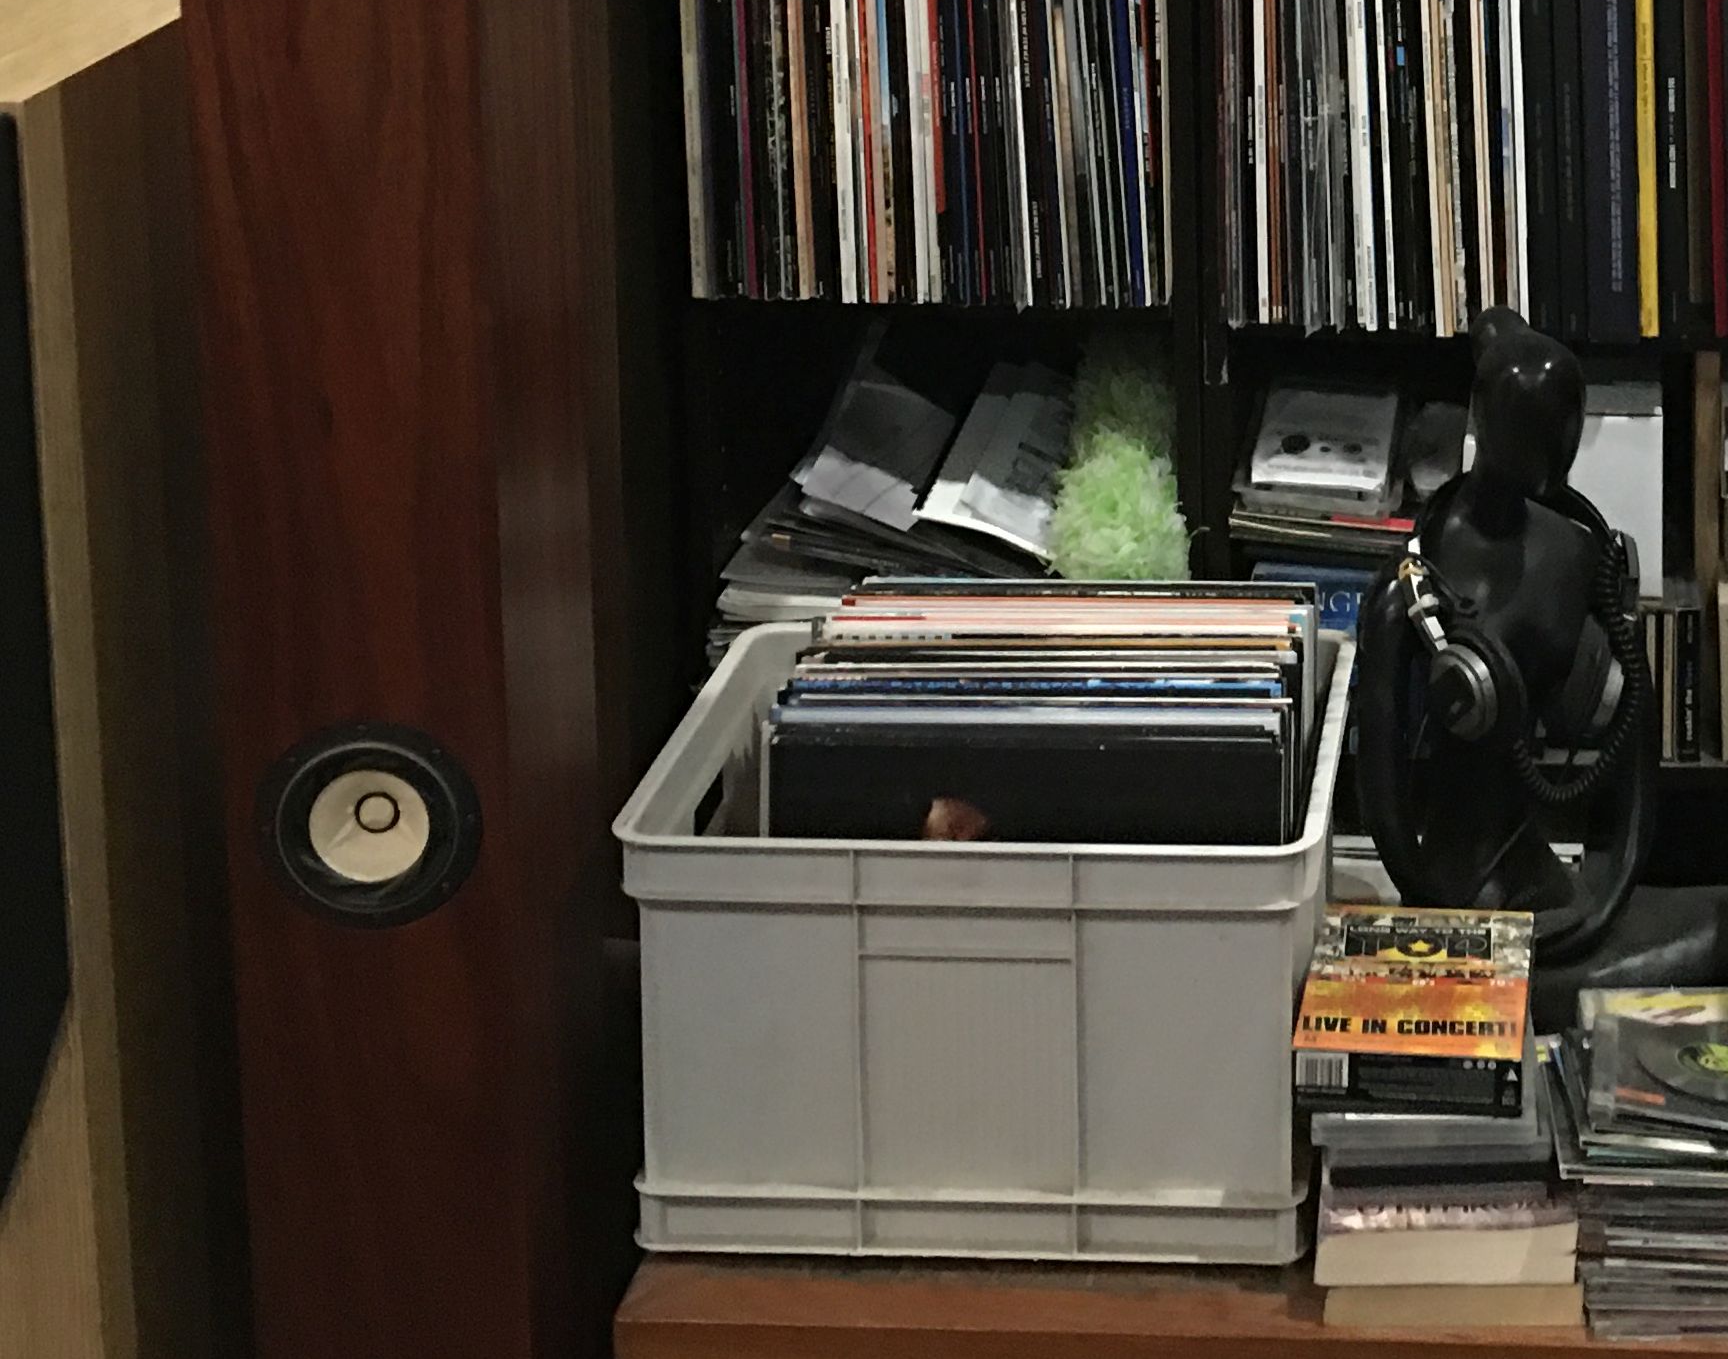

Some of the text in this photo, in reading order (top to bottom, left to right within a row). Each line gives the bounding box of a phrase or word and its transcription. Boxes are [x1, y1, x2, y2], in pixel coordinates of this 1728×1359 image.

[1302, 1015, 1517, 1037] LIVE IN CONCERT!
